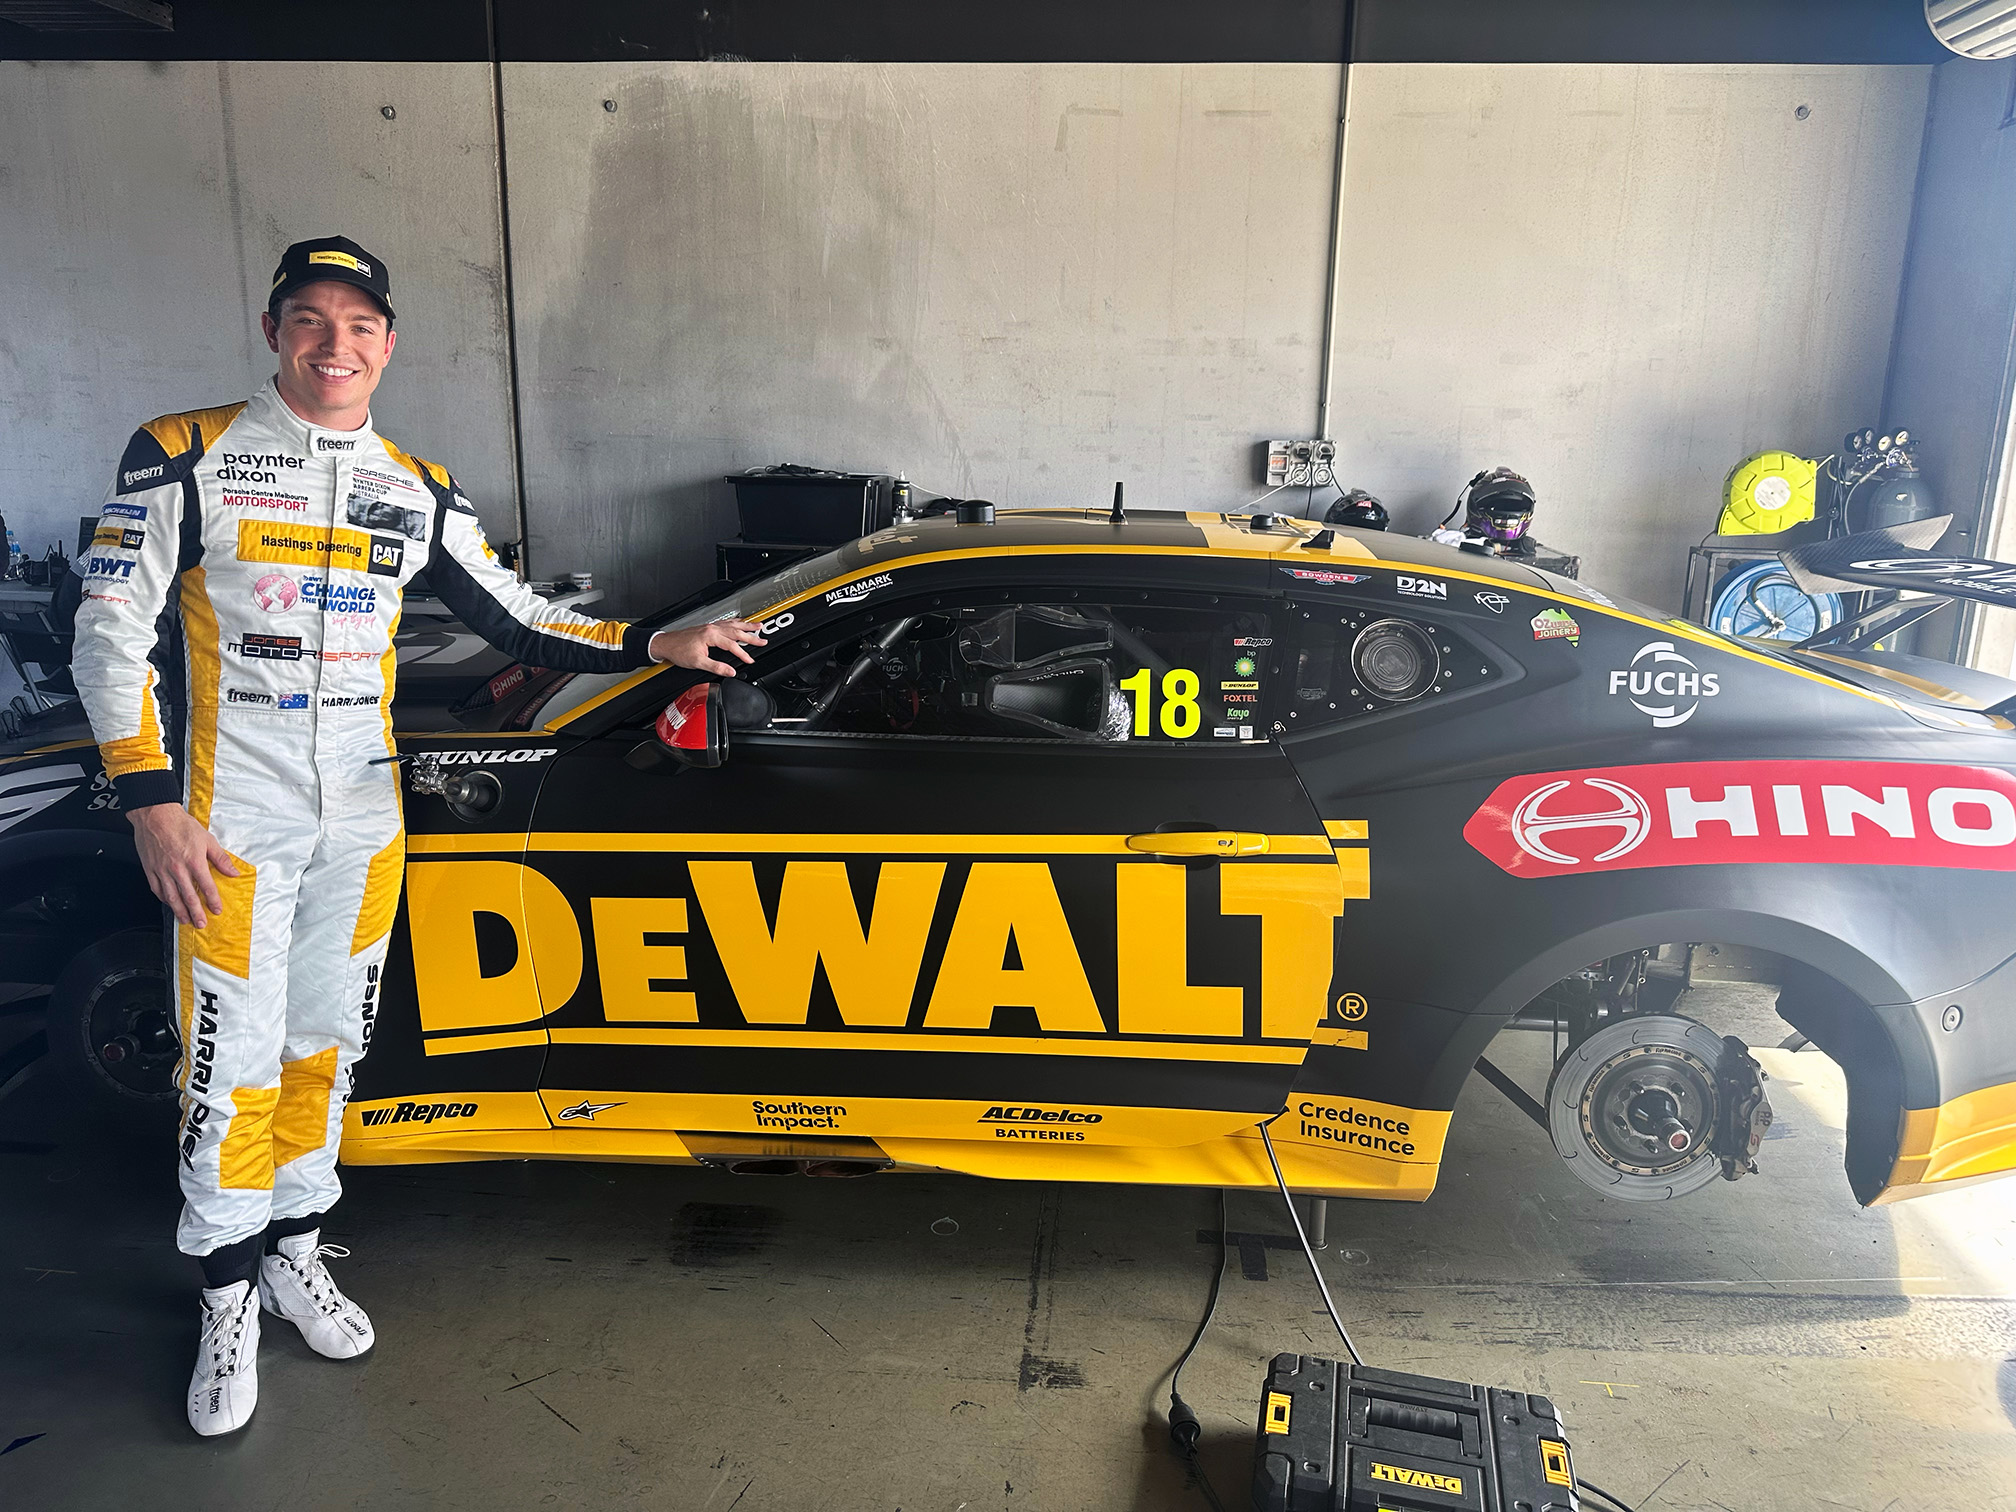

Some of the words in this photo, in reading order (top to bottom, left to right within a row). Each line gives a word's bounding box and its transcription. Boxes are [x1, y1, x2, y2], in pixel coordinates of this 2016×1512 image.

[316, 437, 356, 451] freem
[222, 452, 306, 470] paynter
[216, 465, 277, 484] dixon
[222, 487, 250, 496] Porsche
[250, 488, 274, 498] Centre
[274, 491, 309, 502] Melbourne
[222, 494, 309, 513] MOTORSPORT
[123, 533, 143, 546] CAT
[261, 534, 314, 552] Hastings
[371, 543, 403, 567] CAT
[88, 556, 137, 578] BWT
[825, 572, 893, 603] METAMARK
[300, 596, 317, 605] THE
[1537, 626, 1578, 639] JOINERY
[500, 669, 525, 692] HINO
[1608, 669, 1721, 699] FUCHS
[227, 688, 272, 705] freem
[321, 696, 353, 708] HARRI
[352, 695, 380, 707] JONES
[1119, 667, 1202, 739] 18
[1223, 694, 1258, 703] FOXTEL
[1227, 707, 1250, 721] Kayo
[1664, 783, 2016, 848] HINO
[191, 988, 218, 1096] HARRI
[390, 1101, 479, 1125] Repco
[751, 1100, 848, 1116] Southern
[981, 1106, 1104, 1124] ACDelco
[755, 1113, 841, 1131] Impact.
[1298, 1101, 1411, 1136] Credence
[995, 1128, 1086, 1142] BATTERIES
[1300, 1119, 1416, 1156] Insurance
